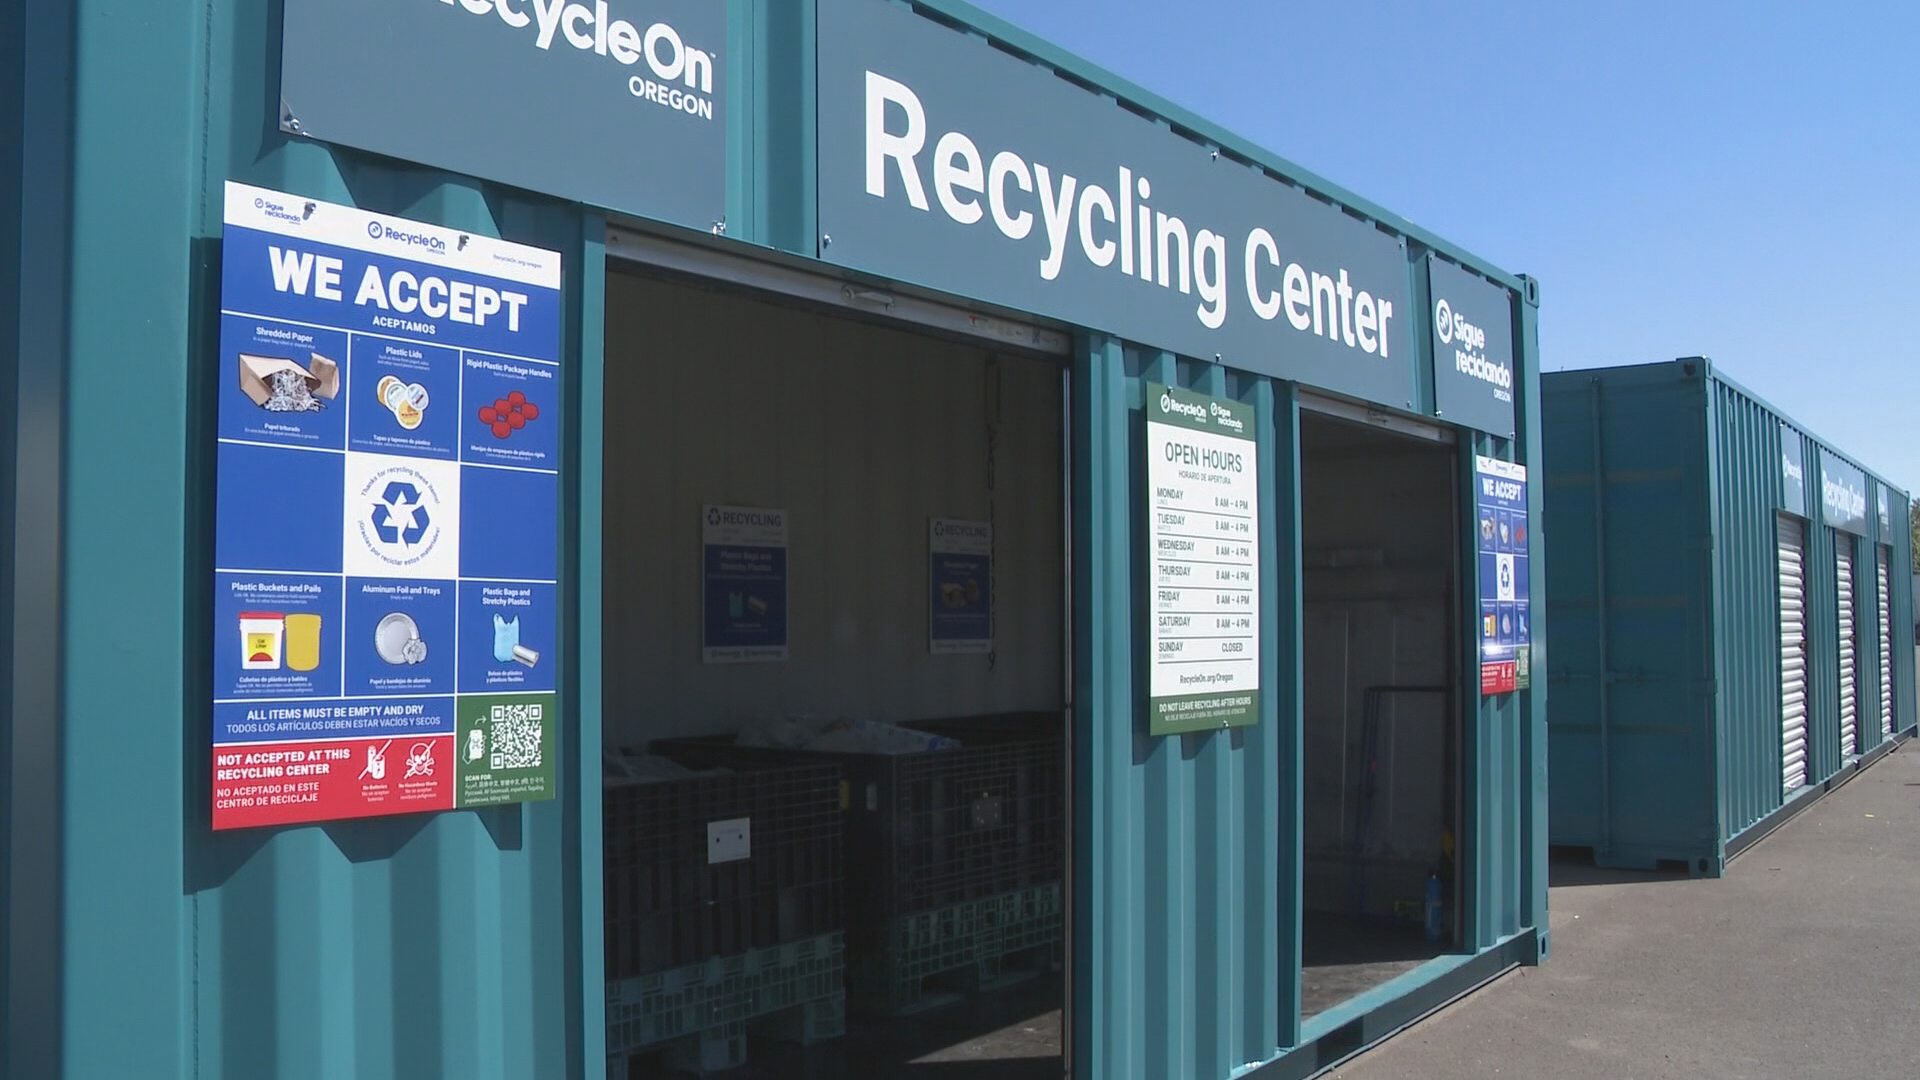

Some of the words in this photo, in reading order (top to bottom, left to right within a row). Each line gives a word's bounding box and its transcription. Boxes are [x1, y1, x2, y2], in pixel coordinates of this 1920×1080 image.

[628, 75, 712, 120] OREGON
[265, 201, 284, 211] Sigue
[865, 70, 1226, 329] Recycling
[1245, 227, 1393, 359] Center
[264, 210, 301, 222] reciclando
[385, 226, 446, 250] RecycleOn
[268, 245, 343, 301] WE
[354, 265, 528, 332] ACCEPT
[372, 315, 436, 335] ACEPTAMOS
[1454, 312, 1485, 352] Sigue
[256, 326, 291, 339] Shredded
[292, 332, 313, 343] Paper
[385, 346, 408, 357] Plastic
[408, 350, 422, 359] Lids
[466, 359, 482, 369] Rigid
[483, 361, 503, 372] Plastic
[504, 364, 528, 376] Package
[528, 368, 552, 379] Handles
[1455, 349, 1511, 389] reciclando
[1165, 442, 1199, 466] OPEN
[1202, 448, 1242, 473] HOURS
[1178, 470, 1200, 481] HORARIO
[1200, 473, 1207, 482] DE
[1208, 474, 1231, 485] APERTURA
[1482, 478, 1495, 496] WE
[1495, 480, 1521, 501] ACCEPT
[1156, 487, 1184, 500] MONDAY
[1215, 496, 1218, 506] 8
[1220, 498, 1229, 508] AM
[1234, 500, 1238, 508] 4
[1240, 500, 1248, 510] PM
[723, 511, 782, 527] RECYCLING
[1158, 512, 1185, 526] TUESDAY
[1216, 520, 1219, 530] 8
[1220, 521, 1229, 531] AM
[1236, 523, 1239, 532] 4
[1240, 524, 1249, 532] PM
[1158, 539, 1195, 551] WEDNESDAY
[1216, 545, 1219, 555] 8
[1221, 546, 1230, 556] AM
[1236, 548, 1239, 556] 4
[1240, 548, 1249, 557] PM
[1158, 565, 1191, 576] THURSDAY
[1216, 570, 1219, 580] 8
[1221, 570, 1230, 580] AM
[1236, 572, 1239, 580] 4
[1240, 572, 1249, 581] PM
[232, 582, 258, 592] Plastic
[258, 583, 288, 592] Buckets
[289, 584, 303, 592] and
[304, 584, 322, 593] Pails
[362, 585, 396, 594] Aluminum
[396, 586, 409, 594] Foil
[410, 586, 422, 594] and
[423, 586, 440, 596] Trays
[483, 587, 503, 596] Plastic
[504, 588, 518, 598] Bags
[519, 588, 531, 596] and
[482, 597, 507, 607] Stretchy
[508, 598, 531, 606] Plastics
[1158, 590, 1180, 602] FRIDAY
[1216, 595, 1220, 604] 8
[1221, 595, 1230, 604] AM
[1236, 596, 1240, 604] 4
[1240, 595, 1250, 604] PM
[1158, 616, 1191, 627] SATURDAY
[1216, 619, 1220, 628] 8
[1221, 619, 1230, 628] AM
[1236, 619, 1240, 628] 4
[1240, 619, 1250, 628] PM
[1158, 642, 1184, 652] SUNDAY
[1222, 642, 1243, 652] CLOSED
[246, 709, 267, 721] ALL
[268, 708, 302, 720] ITEMS
[302, 707, 333, 719] MUST
[334, 707, 347, 718] BE
[348, 706, 382, 717] EMPTY
[383, 705, 404, 716] AND
[405, 704, 424, 715] DRY
[1159, 703, 1167, 712] DO
[1168, 702, 1178, 712] NOT
[1179, 701, 1194, 711] LEAVE
[1194, 698, 1220, 710] RECYCLING
[1220, 697, 1235, 707] AFTER
[1236, 696, 1251, 706] HOURS
[226, 723, 257, 734] TODOS
[258, 722, 276, 732] LOS
[276, 720, 324, 732] ARTÍCULOS
[324, 720, 352, 730] DEBEN
[353, 719, 379, 729] ESTAR
[379, 716, 408, 727] VACÍOS
[409, 717, 415, 726] Y
[416, 716, 441, 726] SECOS
[217, 754, 242, 766] NOT
[244, 750, 305, 764] ACCEPTED
[308, 750, 323, 761] AT
[324, 748, 351, 760] THIS
[217, 766, 284, 780] RECYCLING
[286, 763, 330, 776] CENTER
[216, 788, 231, 798] NO
[233, 784, 282, 797] ACEPTADO
[283, 783, 296, 792] EN
[297, 782, 320, 791] ESTE
[216, 798, 254, 809] CENTRO
[256, 796, 269, 806] DE
[270, 792, 318, 805] RECICLAJE
